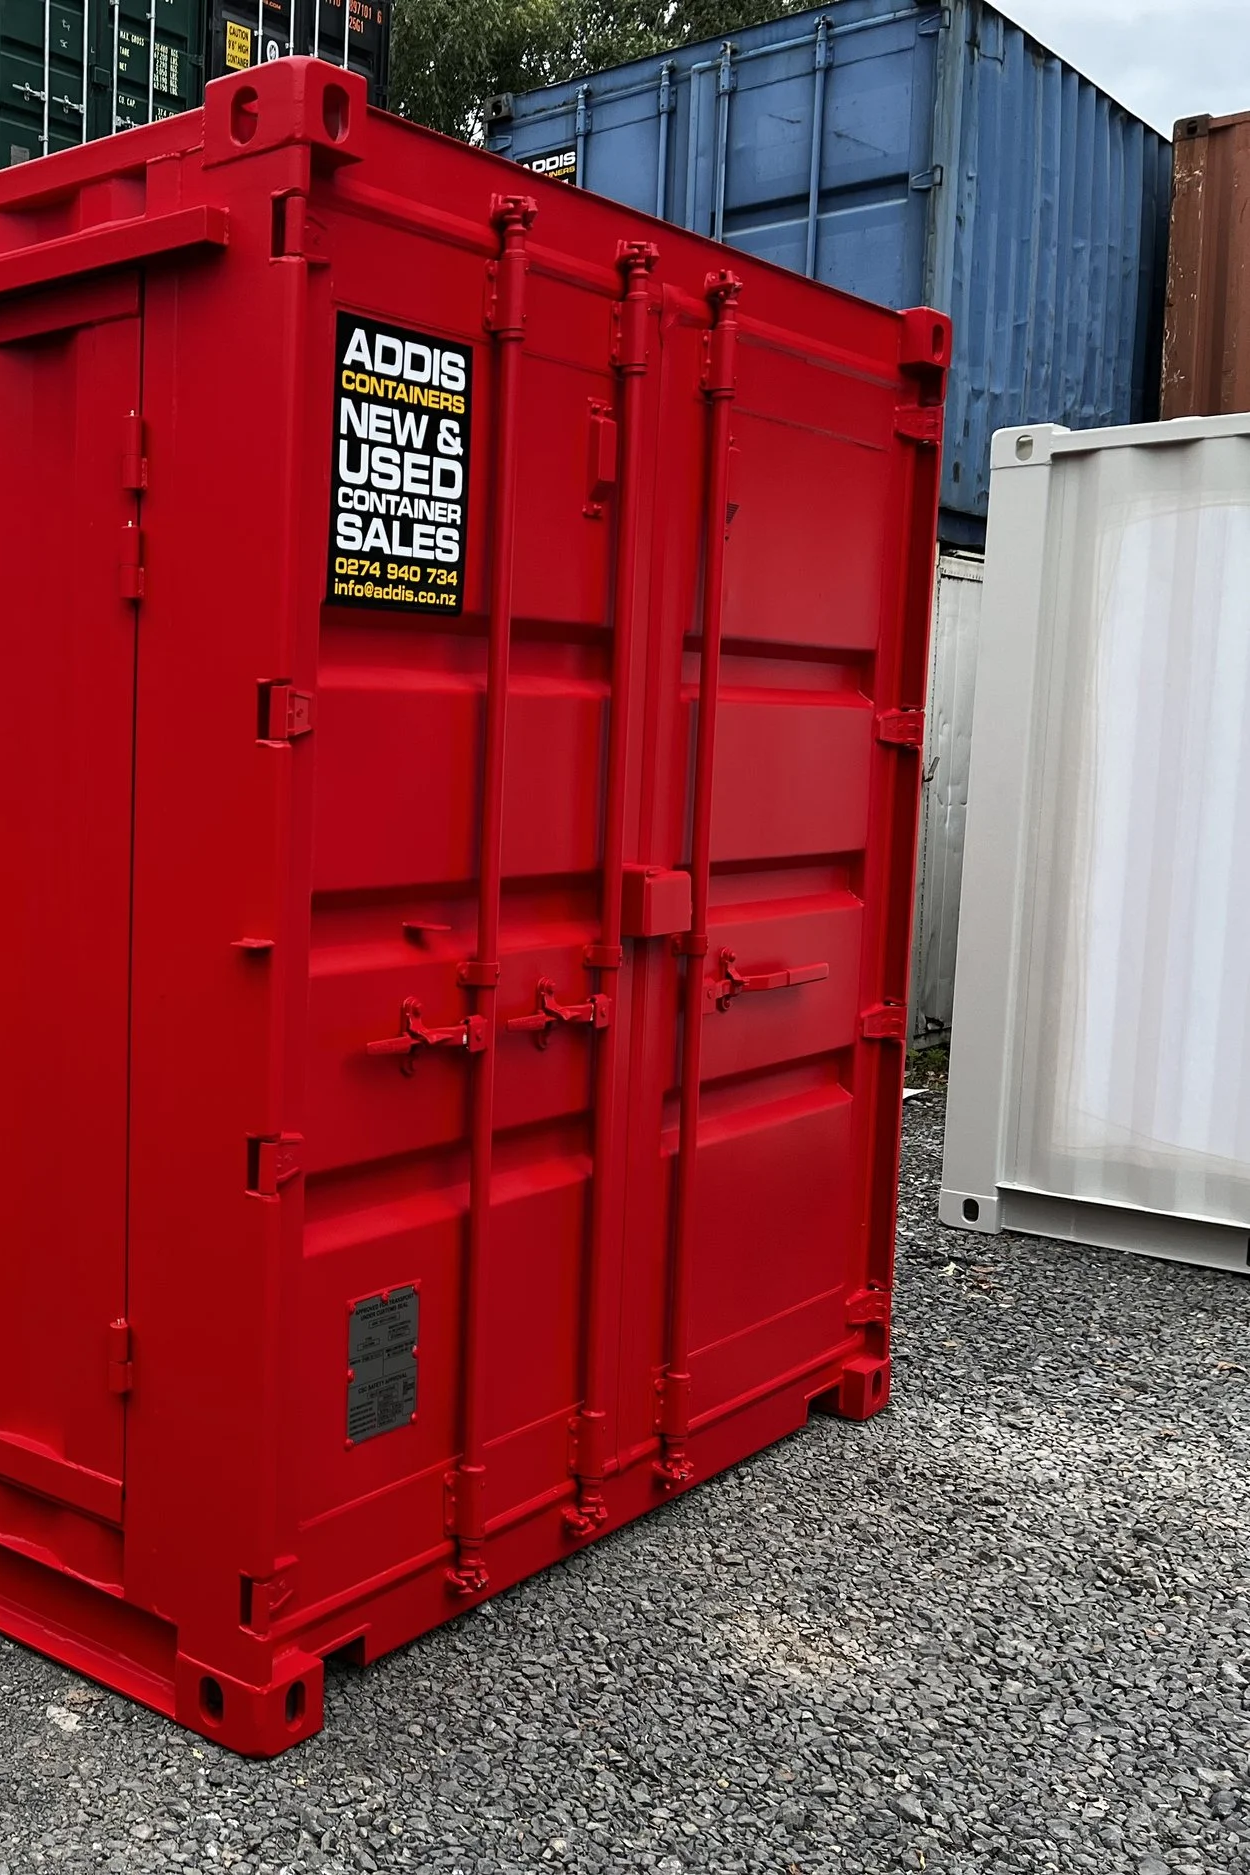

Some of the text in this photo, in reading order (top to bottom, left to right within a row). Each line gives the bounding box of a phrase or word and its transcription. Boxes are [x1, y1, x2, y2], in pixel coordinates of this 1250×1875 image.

[377, 10, 383, 24] 6
[131, 34, 145, 47] GROSS
[229, 25, 249, 40] CAUTION
[119, 46, 130, 58] TARE
[227, 53, 250, 69] CONTAINER
[238, 42, 249, 55] HIGH
[118, 61, 127, 72] NET
[342, 327, 466, 392] ADDIS
[341, 369, 465, 415] CONTAINERS
[339, 396, 464, 456] NEW &
[338, 439, 463, 500] USED
[337, 486, 462, 525] CONTAINER
[336, 512, 460, 563] SALES
[335, 556, 458, 586] 0274 940 734
[334, 578, 457, 606] info@addis.co.nz
